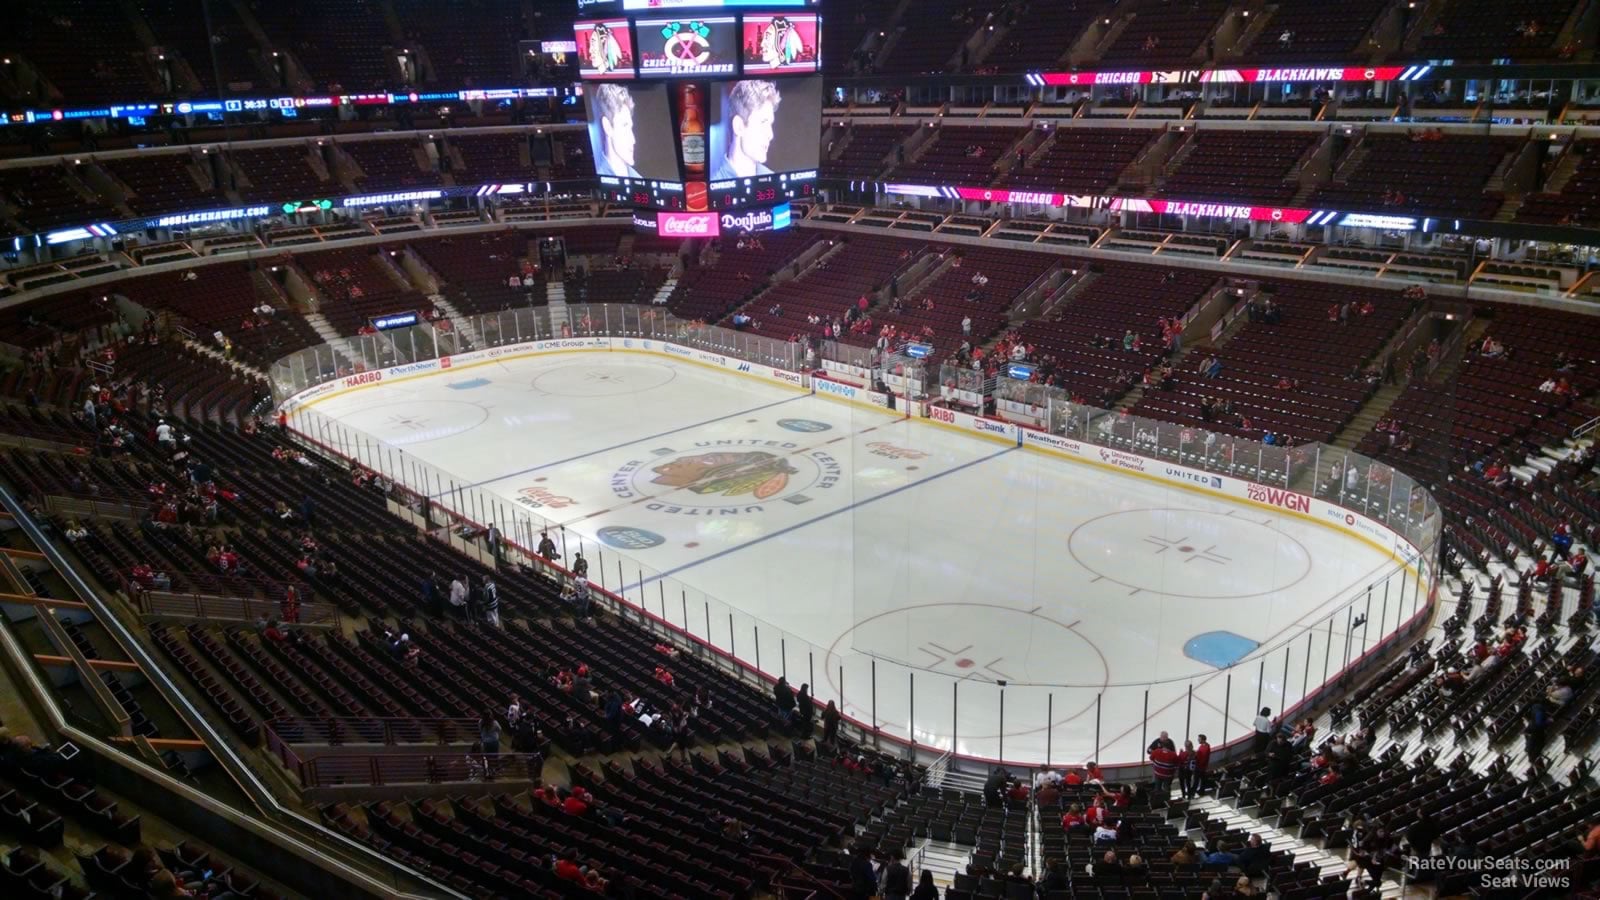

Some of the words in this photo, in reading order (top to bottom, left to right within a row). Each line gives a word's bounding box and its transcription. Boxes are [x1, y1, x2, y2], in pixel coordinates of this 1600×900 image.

[671, 63, 734, 74] BLACKHAWKS
[1256, 68, 1344, 82] BLACKHAWKS
[1095, 71, 1141, 84] CHICAGO
[1008, 191, 1053, 206] CHICAGO
[1165, 201, 1251, 219] BLACKHAWKS
[544, 340, 560, 349] CME
[561, 340, 584, 349] Group
[346, 371, 382, 387] HARIBO
[695, 438, 798, 449] UNITED
[1027, 432, 1080, 450] WeatherTech
[1111, 451, 1144, 465] University
[812, 451, 841, 489] CENTER
[1119, 460, 1145, 472] Phoenix
[611, 459, 645, 499] CENTER
[1165, 467, 1209, 484] UNITED
[1248, 488, 1266, 502] 720
[1266, 487, 1310, 514] WGN
[646, 502, 764, 516] UNITED
